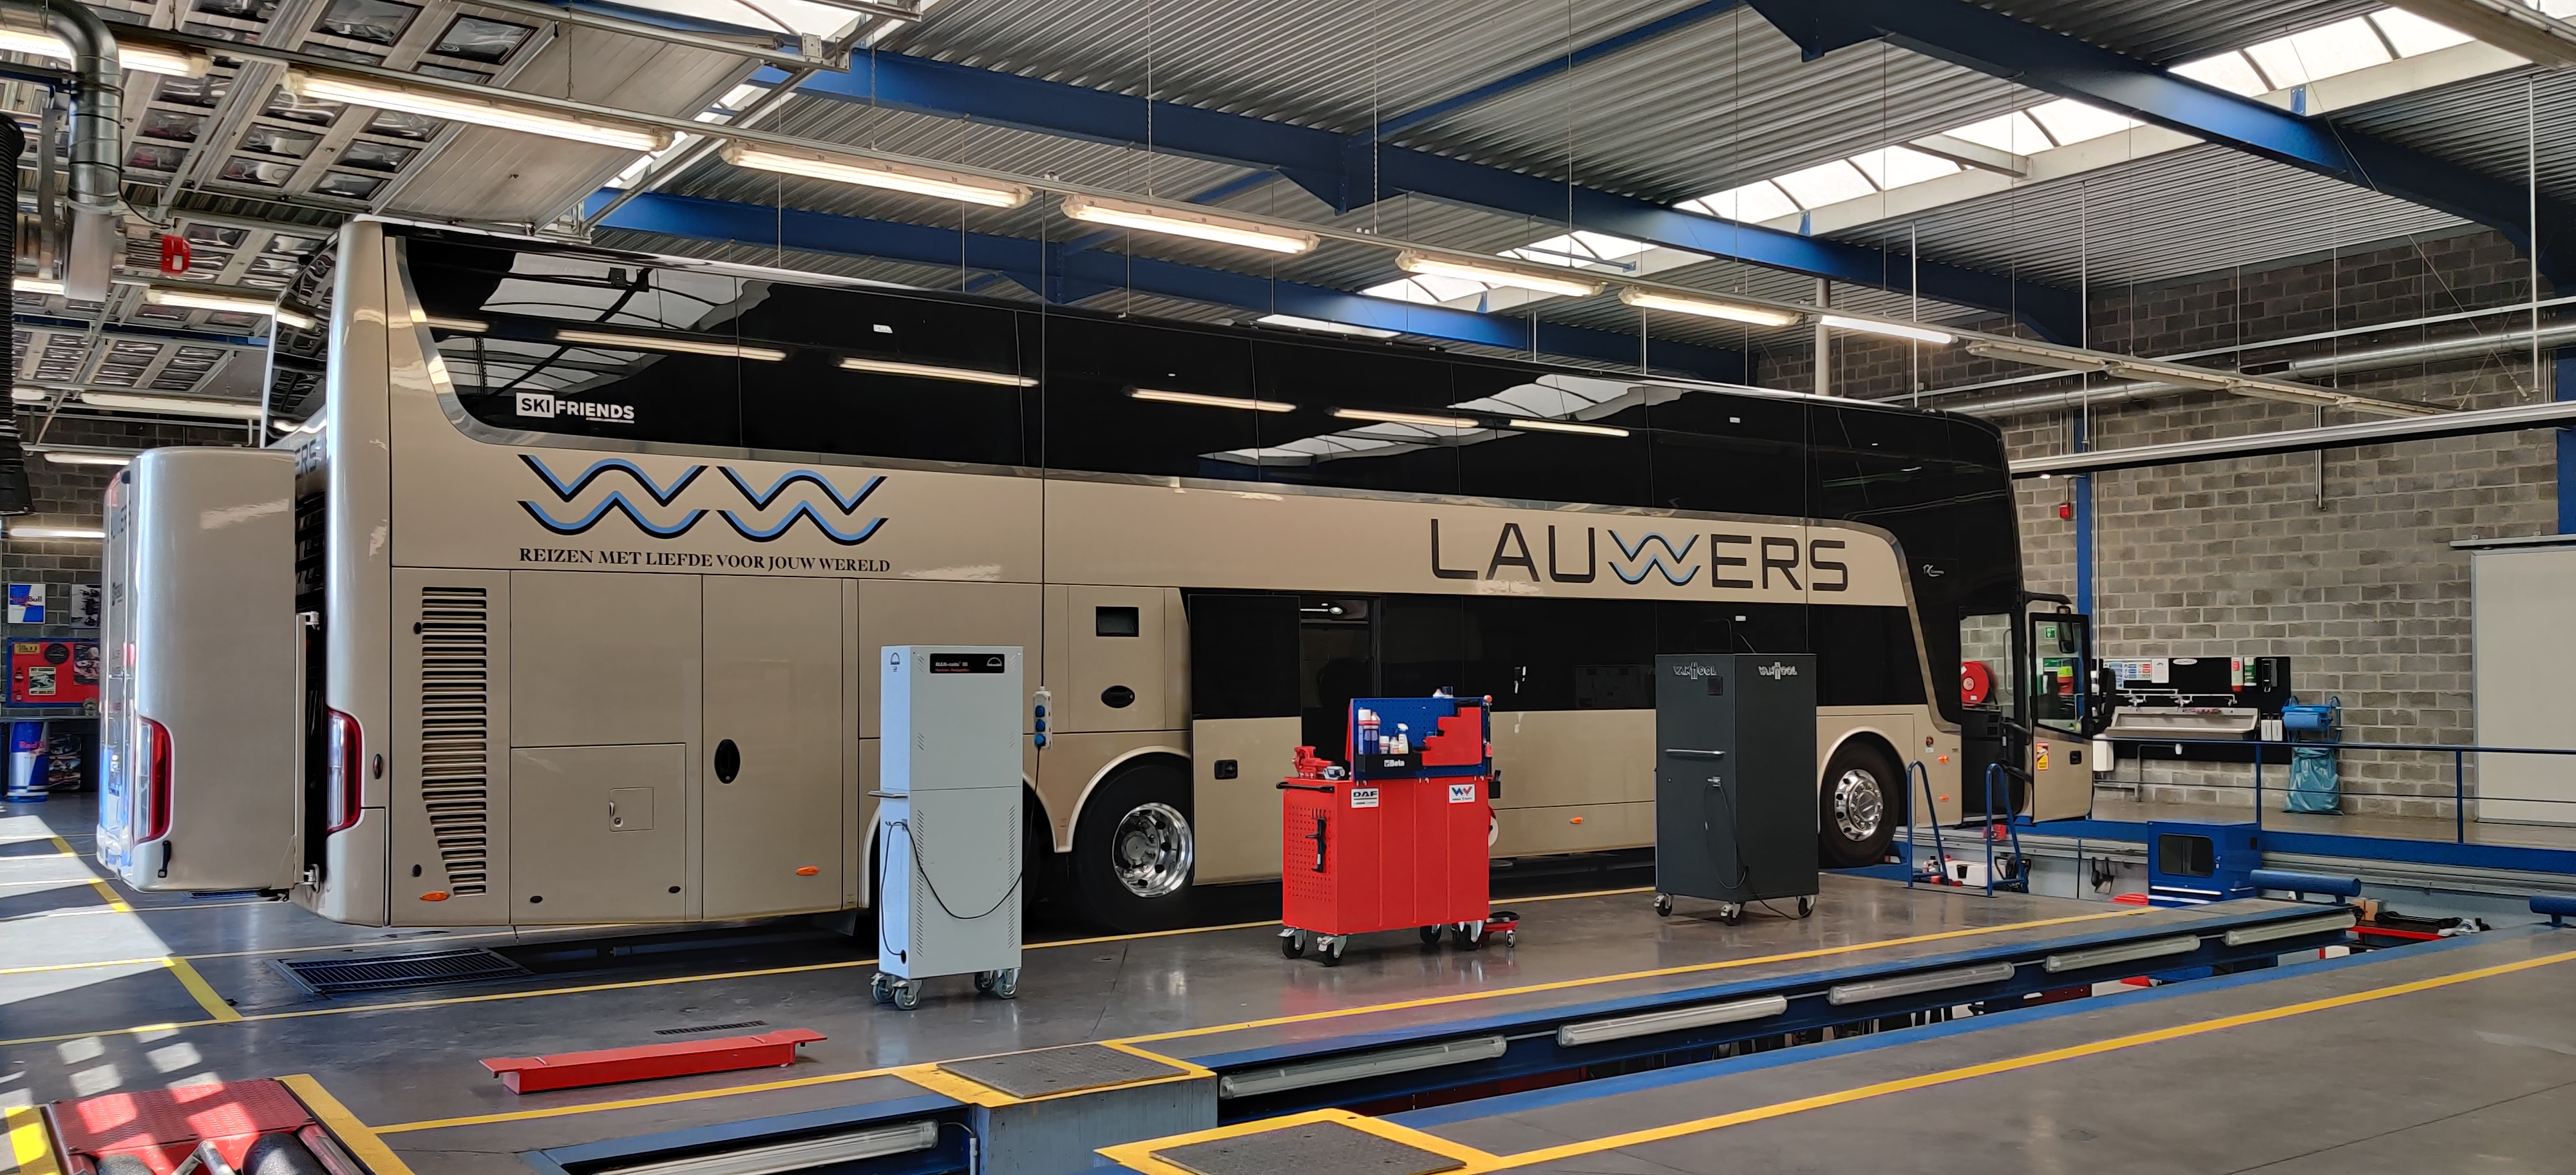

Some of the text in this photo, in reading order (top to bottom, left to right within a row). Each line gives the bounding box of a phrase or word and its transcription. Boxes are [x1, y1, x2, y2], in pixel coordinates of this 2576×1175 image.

[519, 548, 891, 573] REIZEN MET LIEFDE VOOR JOUW WERELD
[1430, 518, 1849, 592] LAUWERS
